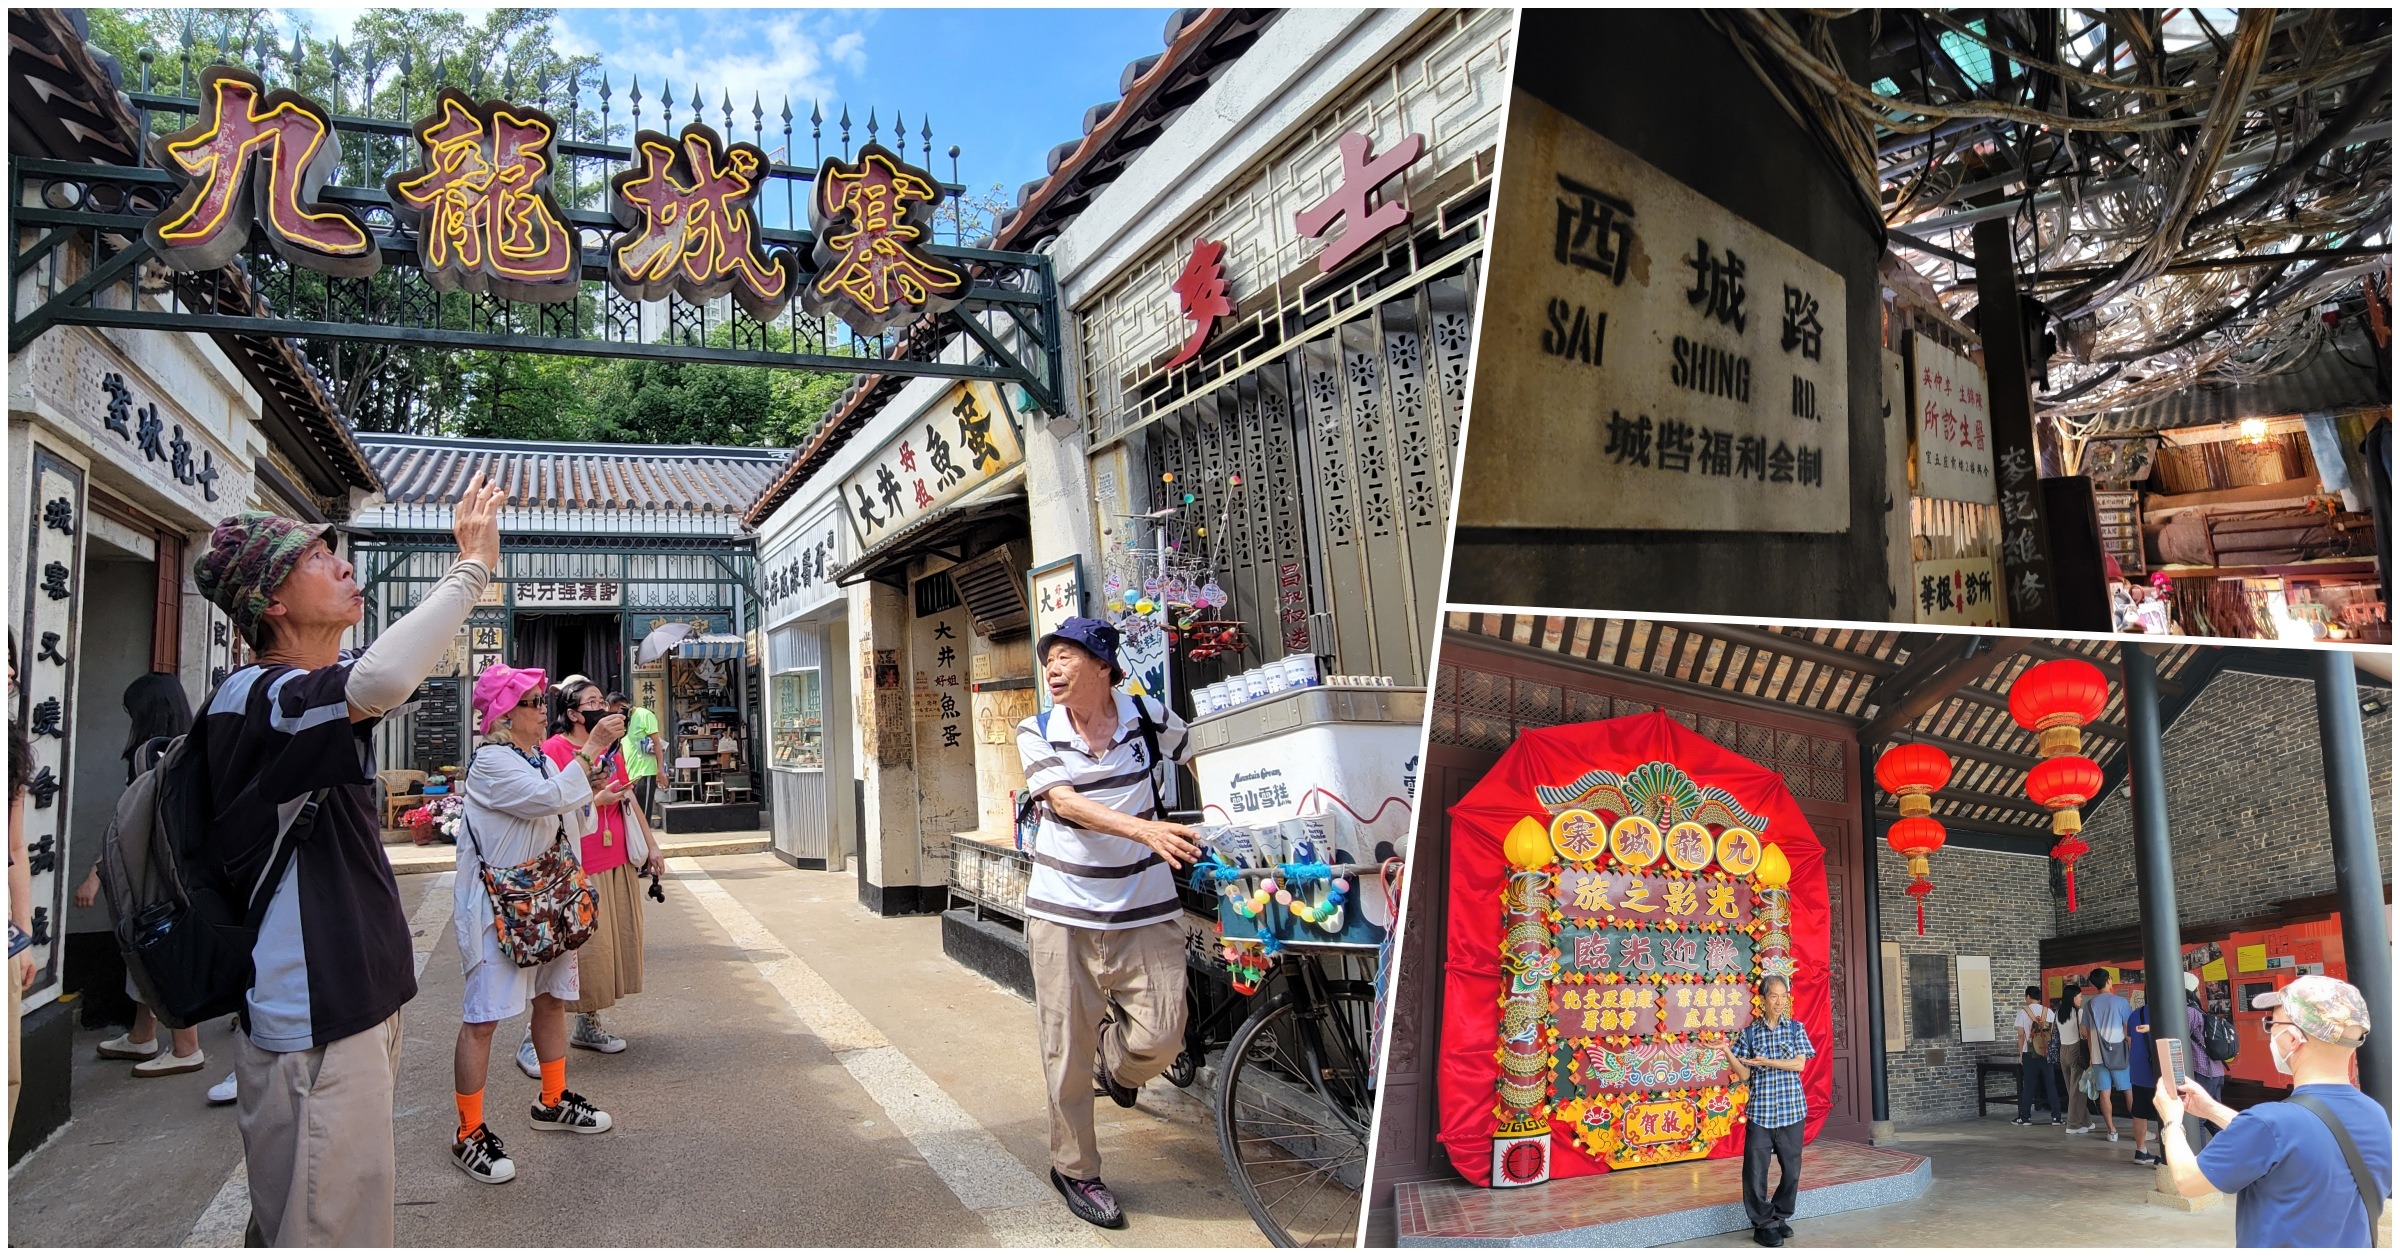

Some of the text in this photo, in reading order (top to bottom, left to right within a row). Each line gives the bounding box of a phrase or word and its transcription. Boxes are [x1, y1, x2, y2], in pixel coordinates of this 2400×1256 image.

[1555, 171, 1825, 364] 西城路
[1541, 296, 1823, 423] SAI SHING RD.
[1230, 783, 1290, 813] 雪山雪糕
